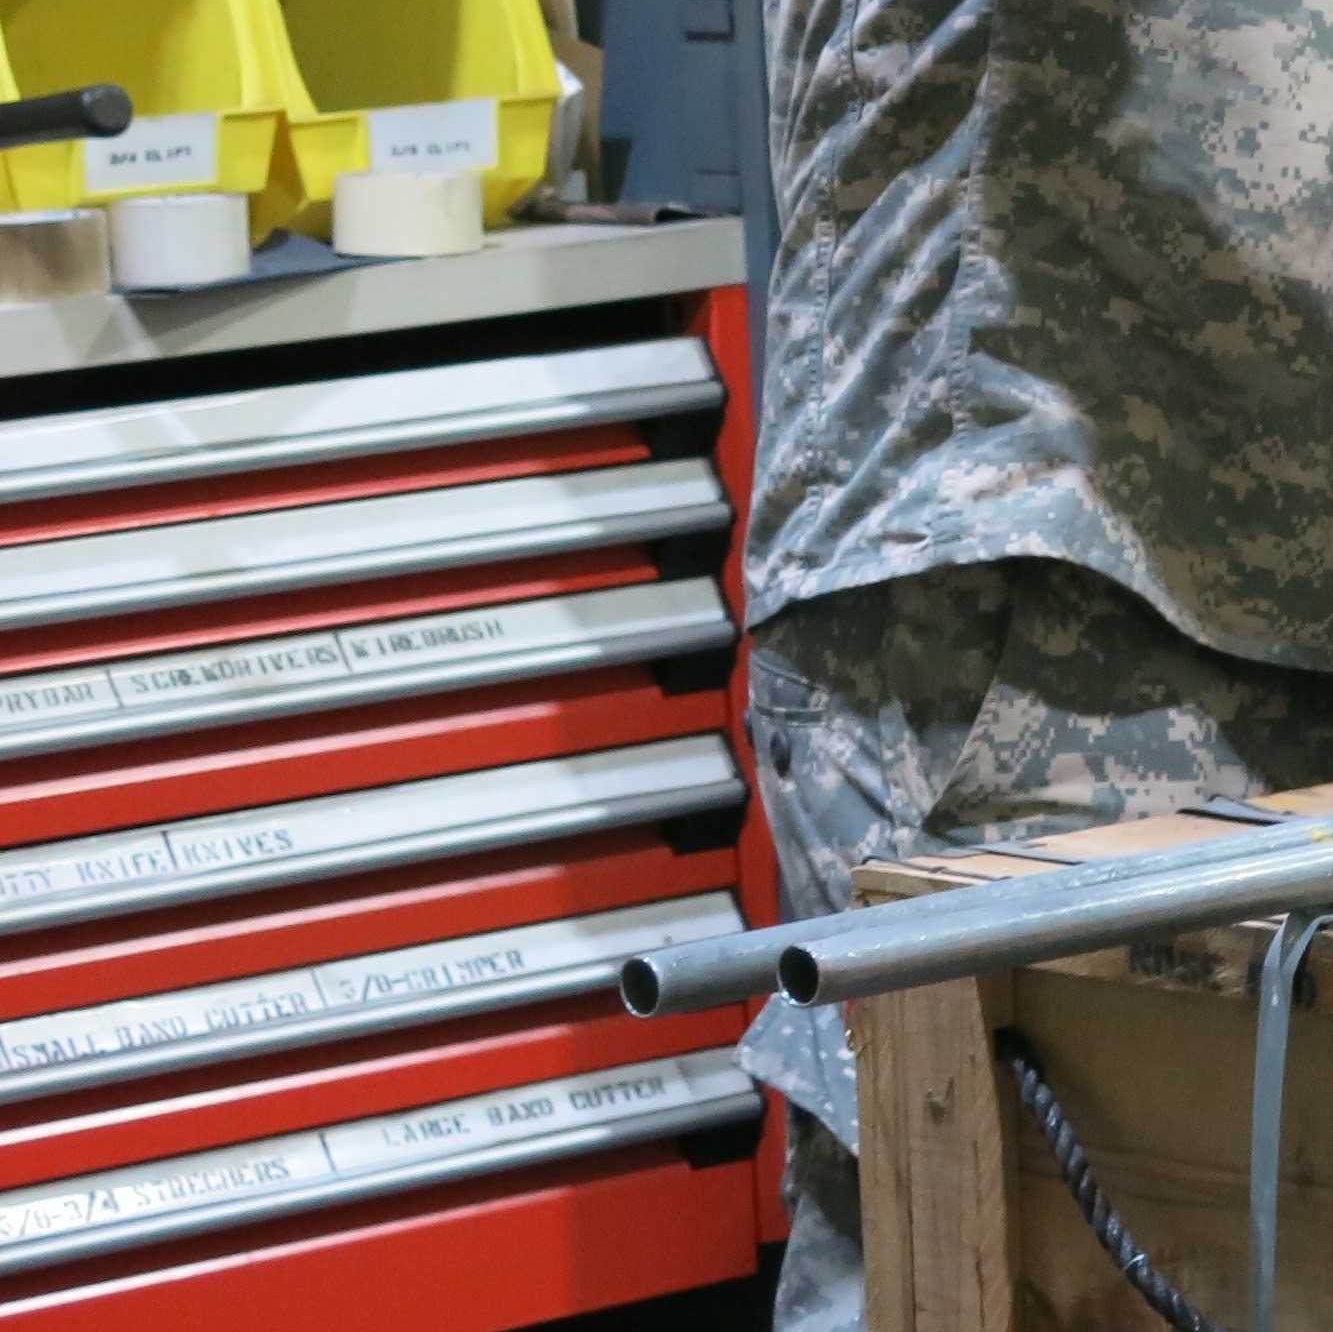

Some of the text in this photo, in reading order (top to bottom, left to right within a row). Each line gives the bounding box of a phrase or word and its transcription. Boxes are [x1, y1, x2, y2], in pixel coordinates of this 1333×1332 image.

[11, 1030, 99, 1067] SMALL
[207, 992, 311, 1032] CUTTER
[382, 1113, 471, 1148] LARGE
[485, 1095, 558, 1128] BAND
[570, 1075, 667, 1113] CUTTER
